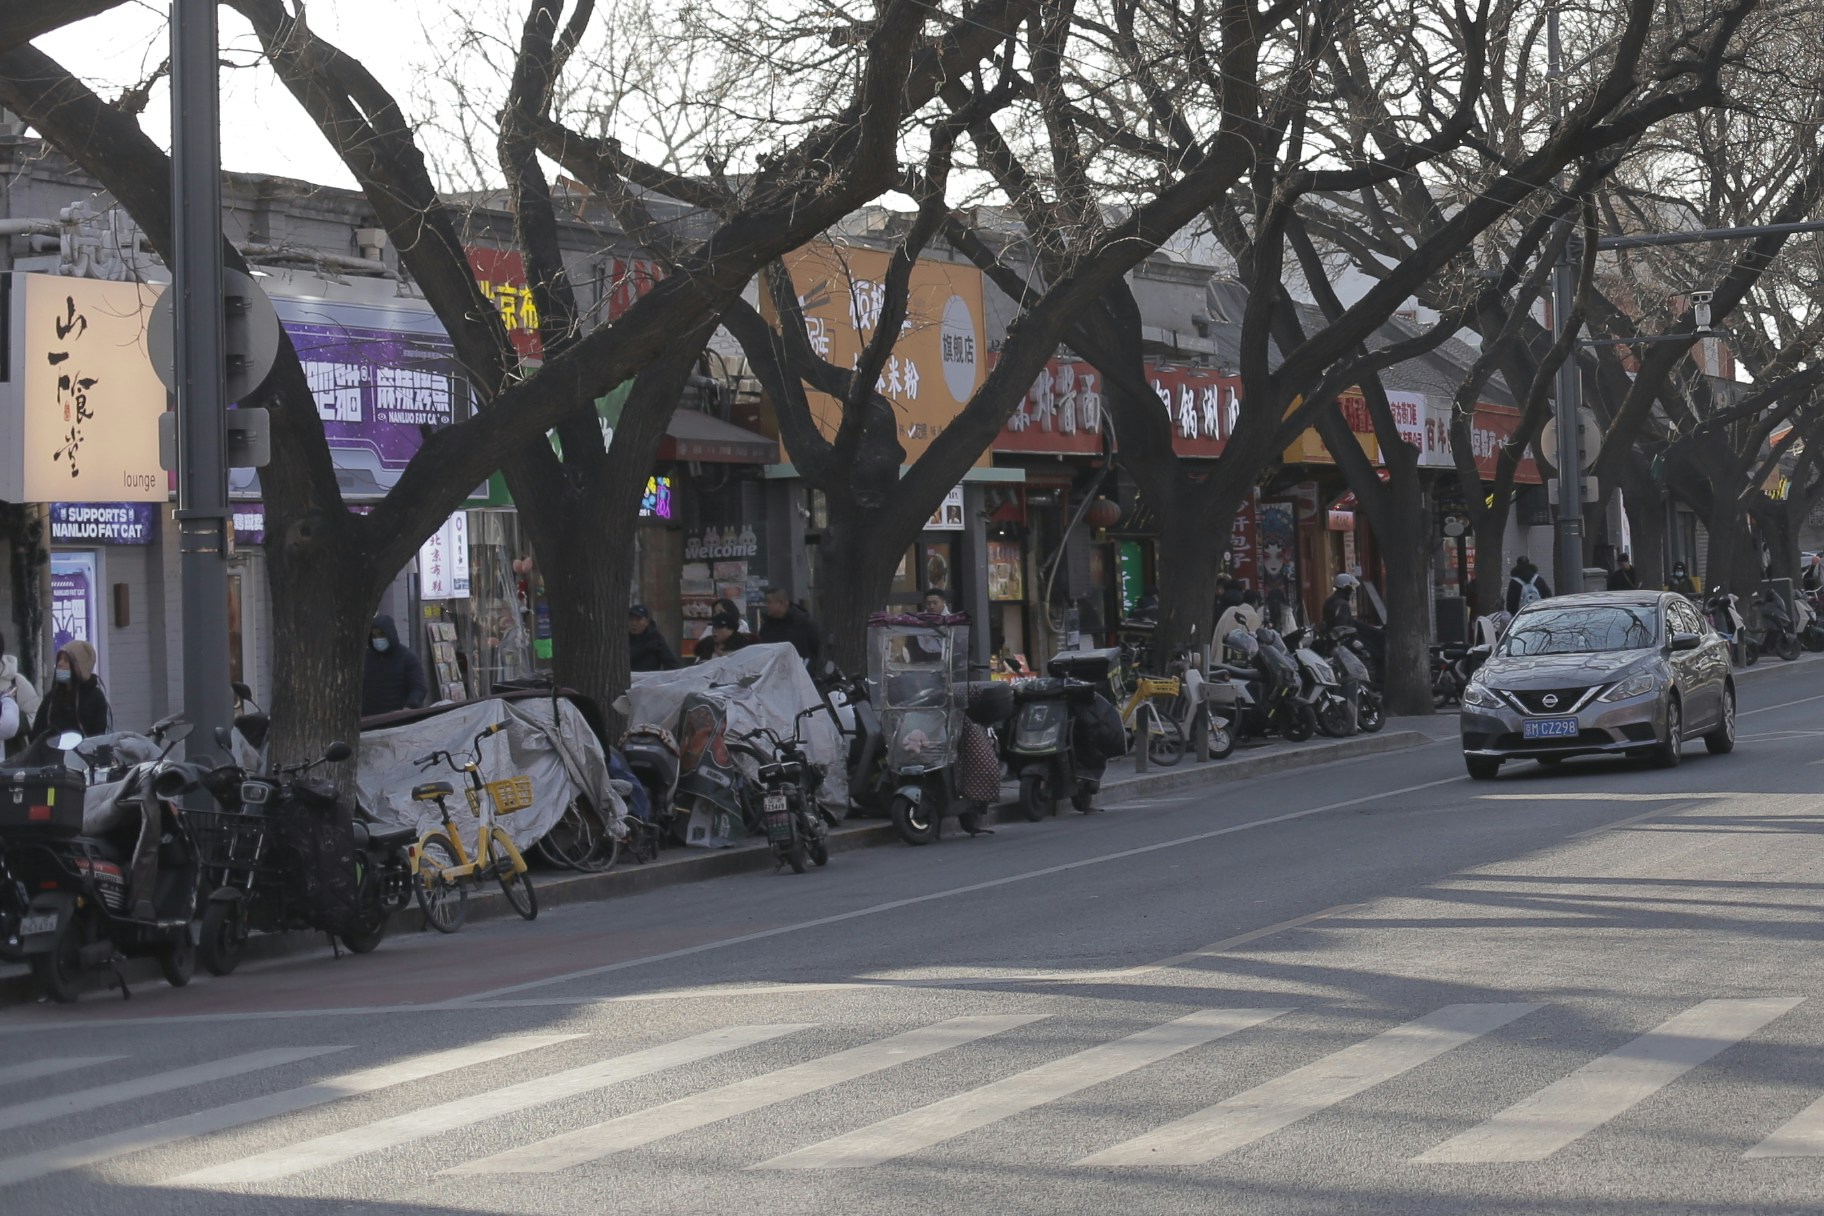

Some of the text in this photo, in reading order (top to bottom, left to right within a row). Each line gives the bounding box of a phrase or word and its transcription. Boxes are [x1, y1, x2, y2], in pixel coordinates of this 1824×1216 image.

[942, 333, 975, 365] 旗舰店
[875, 355, 920, 401] 米粉
[388, 411, 440, 425] NANLUO FAT CA
[123, 470, 156, 492] lounge
[68, 508, 127, 522] SUPPORTS
[52, 522, 142, 538] NANLUO FAT CAT
[685, 544, 757, 560] welcome
